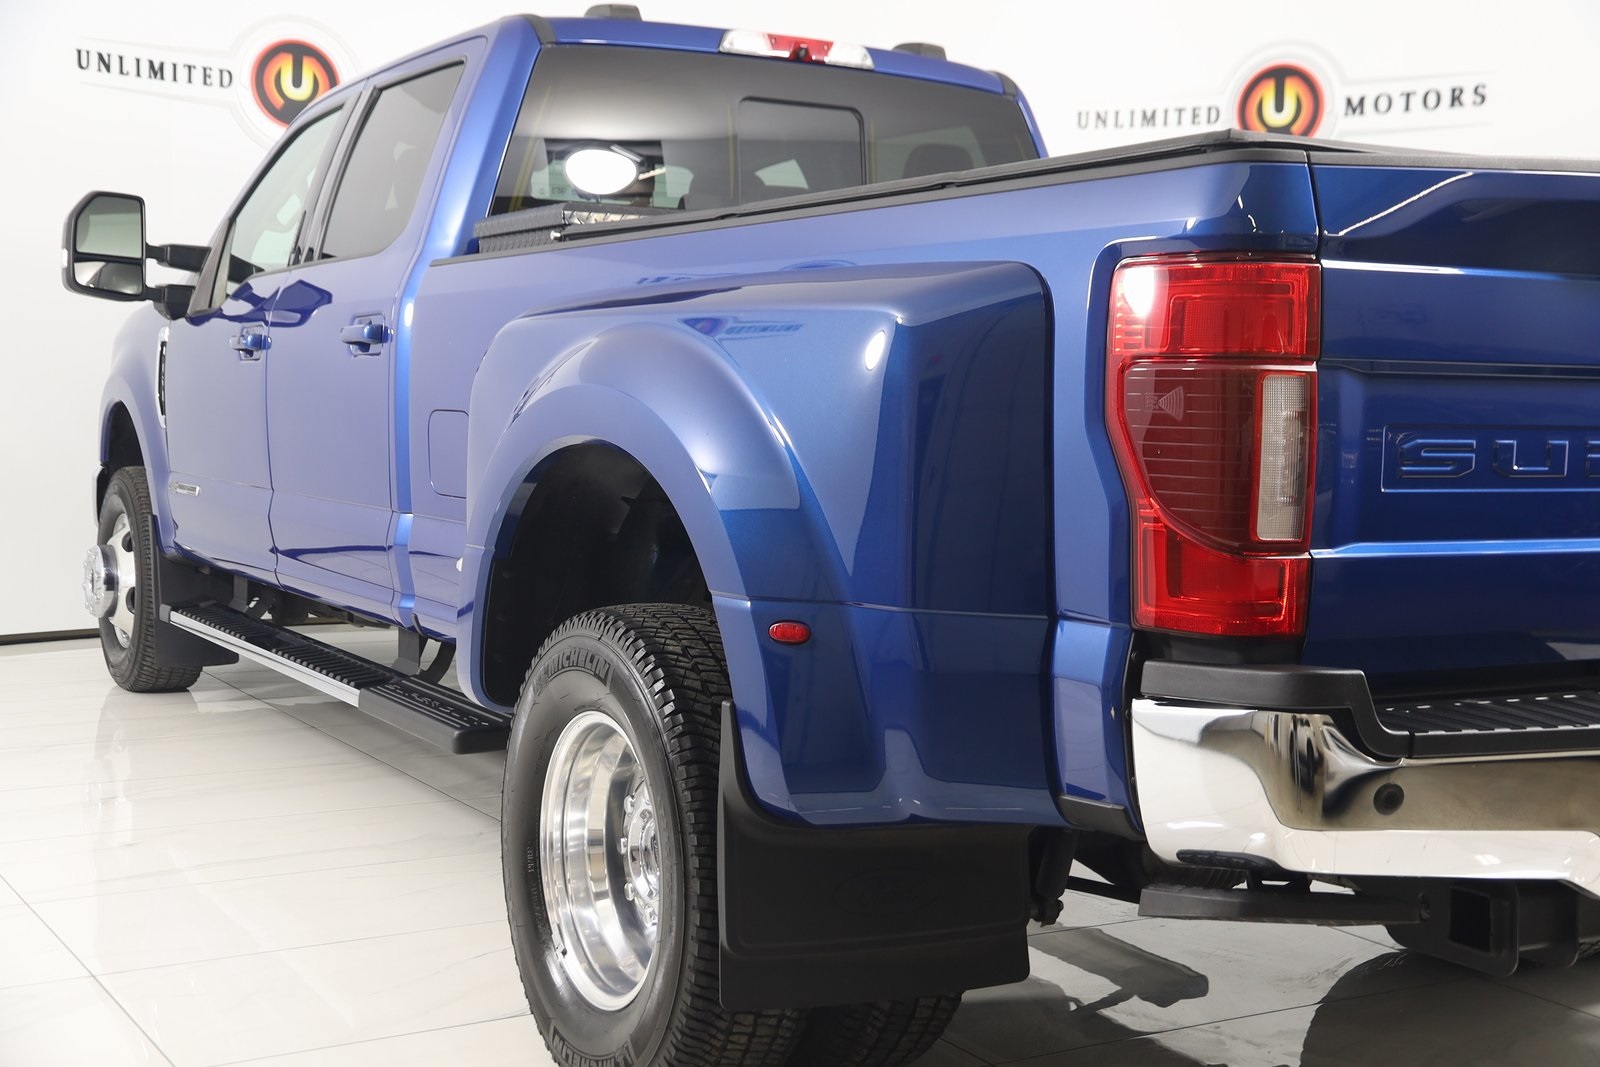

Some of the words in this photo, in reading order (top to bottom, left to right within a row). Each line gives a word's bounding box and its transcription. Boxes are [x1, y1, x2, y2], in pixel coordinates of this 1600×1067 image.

[75, 48, 233, 89] UNLIMITED
[1077, 105, 1220, 130] UNLIMITED
[1344, 84, 1488, 118] MOTORS
[548, 648, 611, 681] MICHELIN
